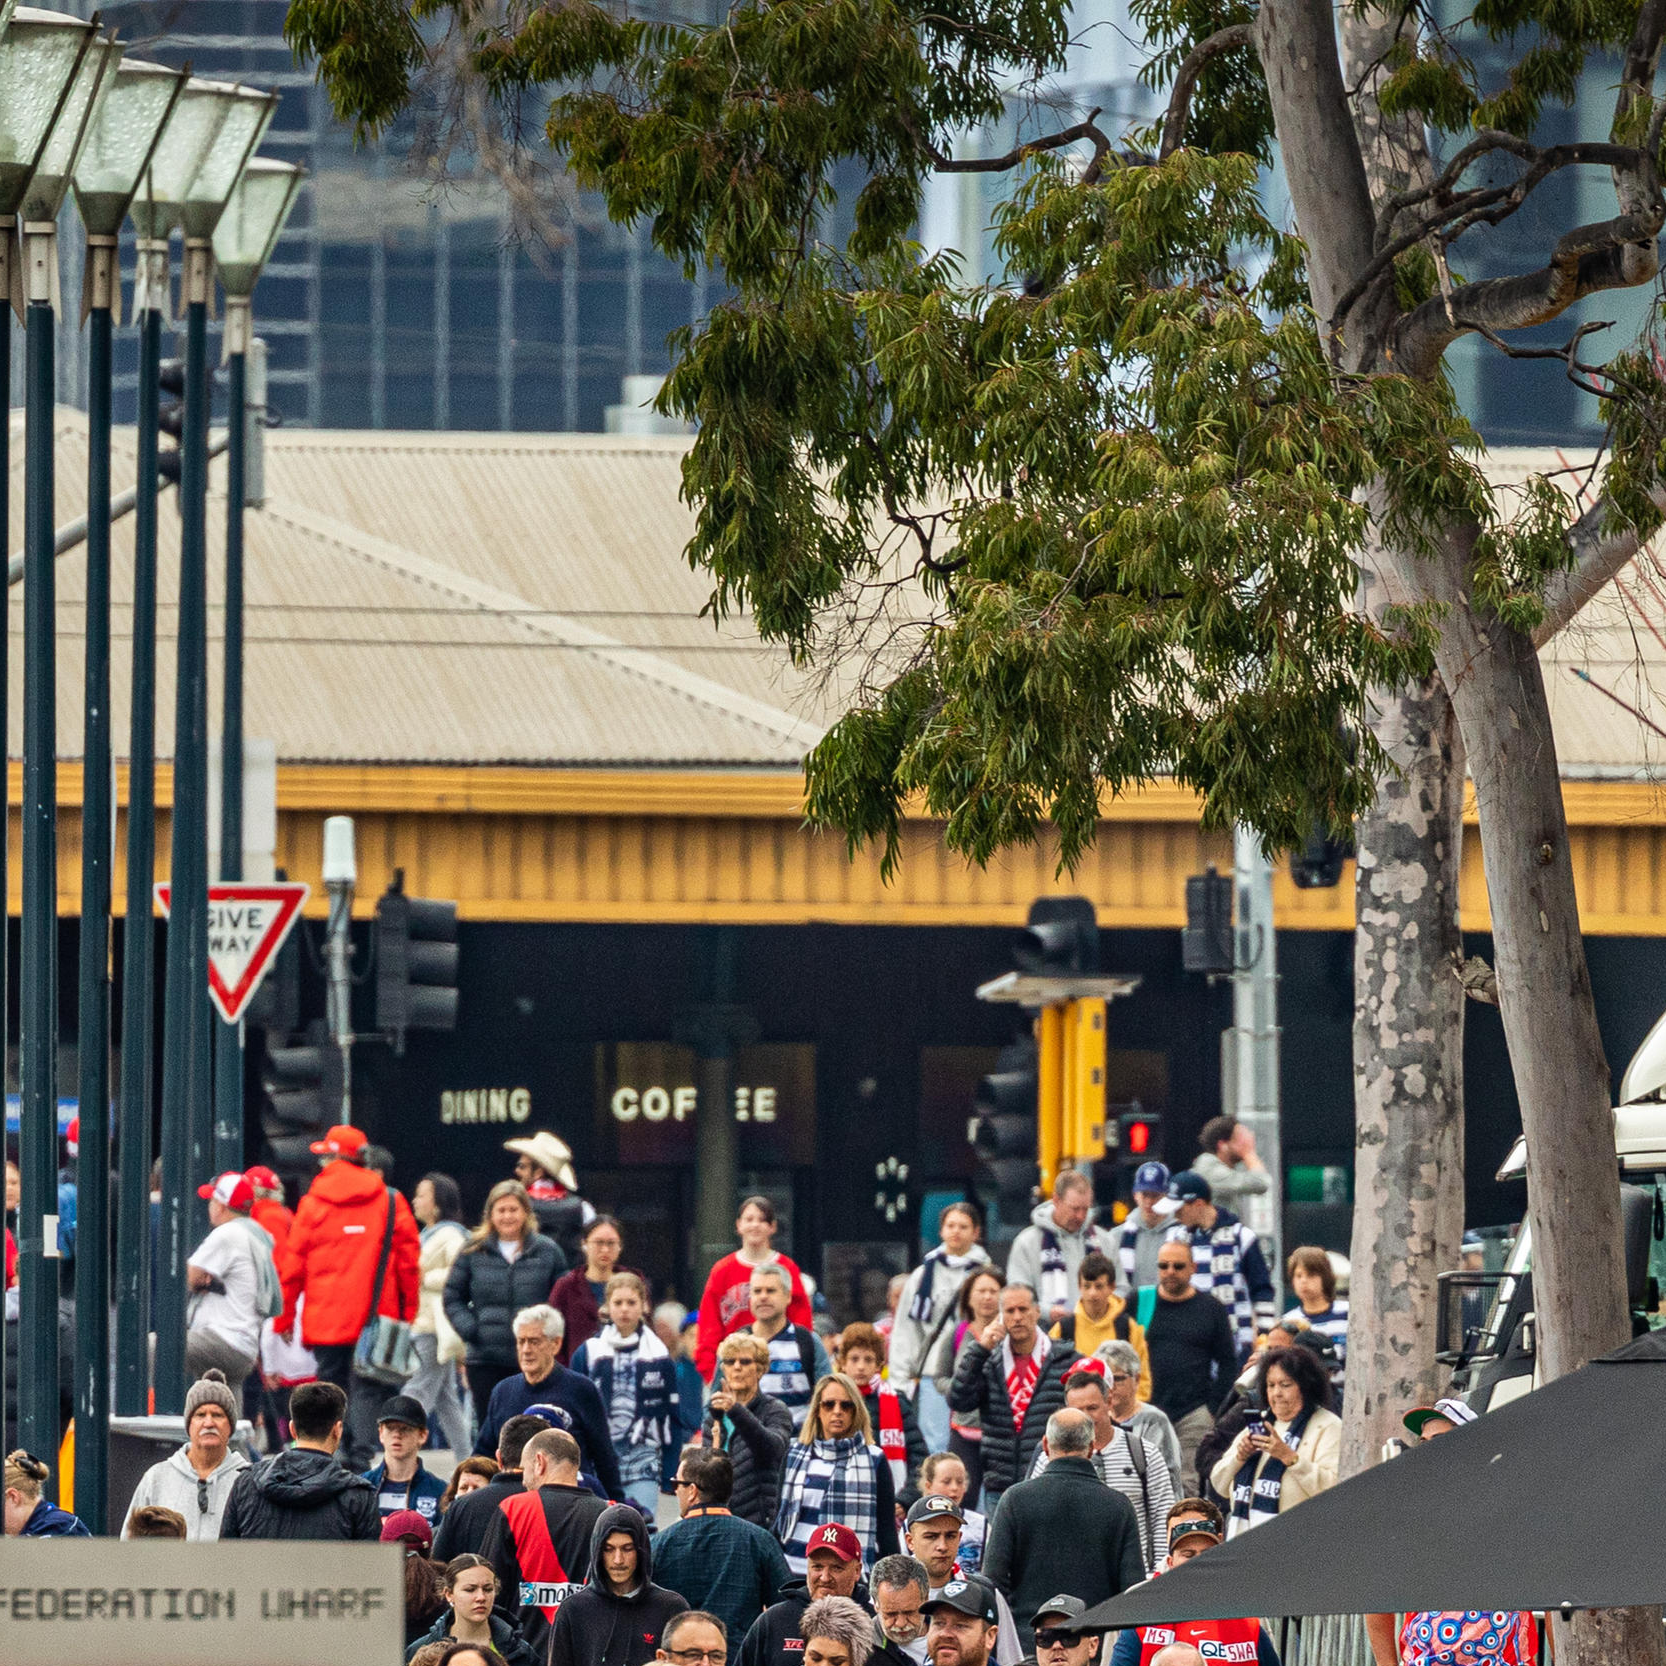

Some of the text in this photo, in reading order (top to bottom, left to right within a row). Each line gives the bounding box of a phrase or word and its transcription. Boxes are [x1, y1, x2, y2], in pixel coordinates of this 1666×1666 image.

[209, 936, 253, 952] WAY
[441, 1088, 531, 1124] DINING
[612, 1087, 776, 1121] COFEE
[261, 1588, 384, 1622] WHARF
